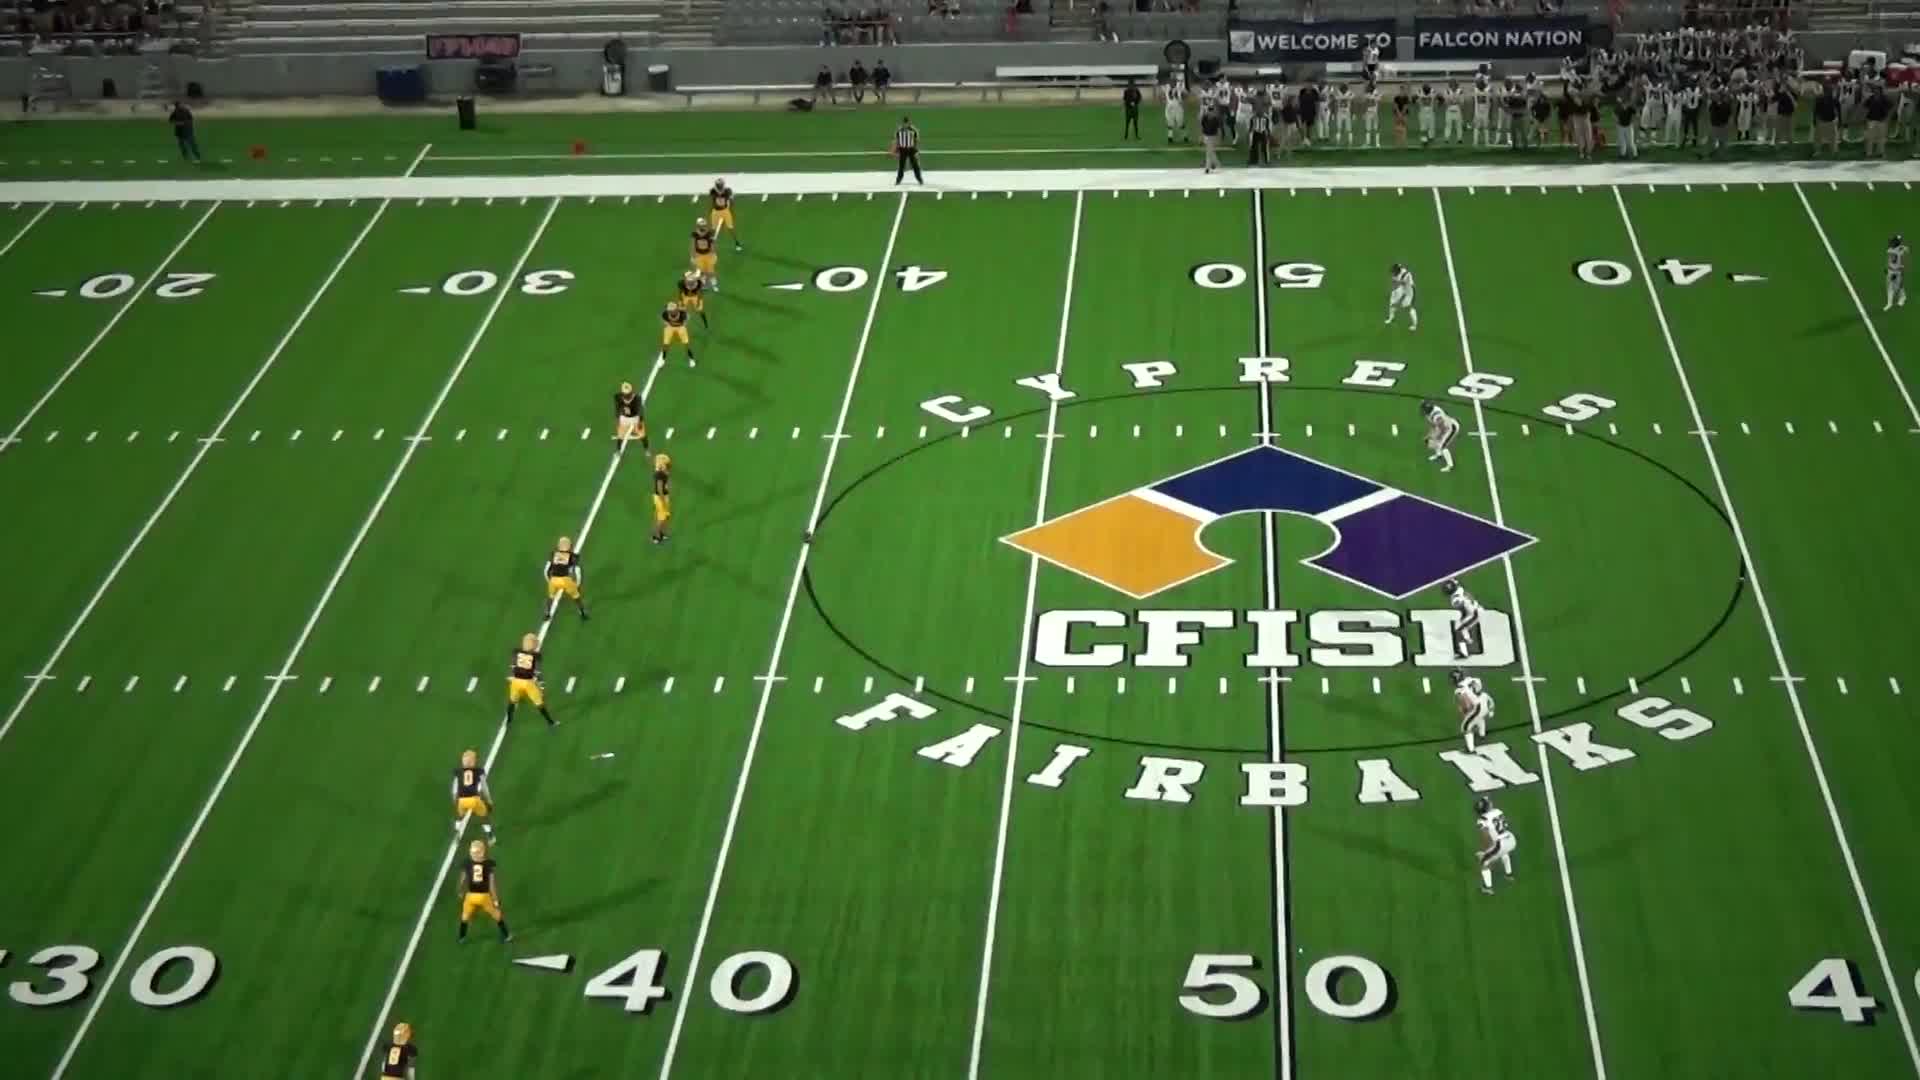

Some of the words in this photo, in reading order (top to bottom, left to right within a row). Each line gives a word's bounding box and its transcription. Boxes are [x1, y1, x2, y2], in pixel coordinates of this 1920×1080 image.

[1257, 33, 1360, 50] WELCOME
[1365, 32, 1391, 48] TO
[1419, 32, 1499, 47] FALCON
[1505, 30, 1582, 46] NATION
[920, 356, 1616, 424] CYPRESS
[1033, 608, 1516, 668] CFISD
[835, 692, 1715, 807] FAIRBANKS
[472, 864, 484, 882] 2
